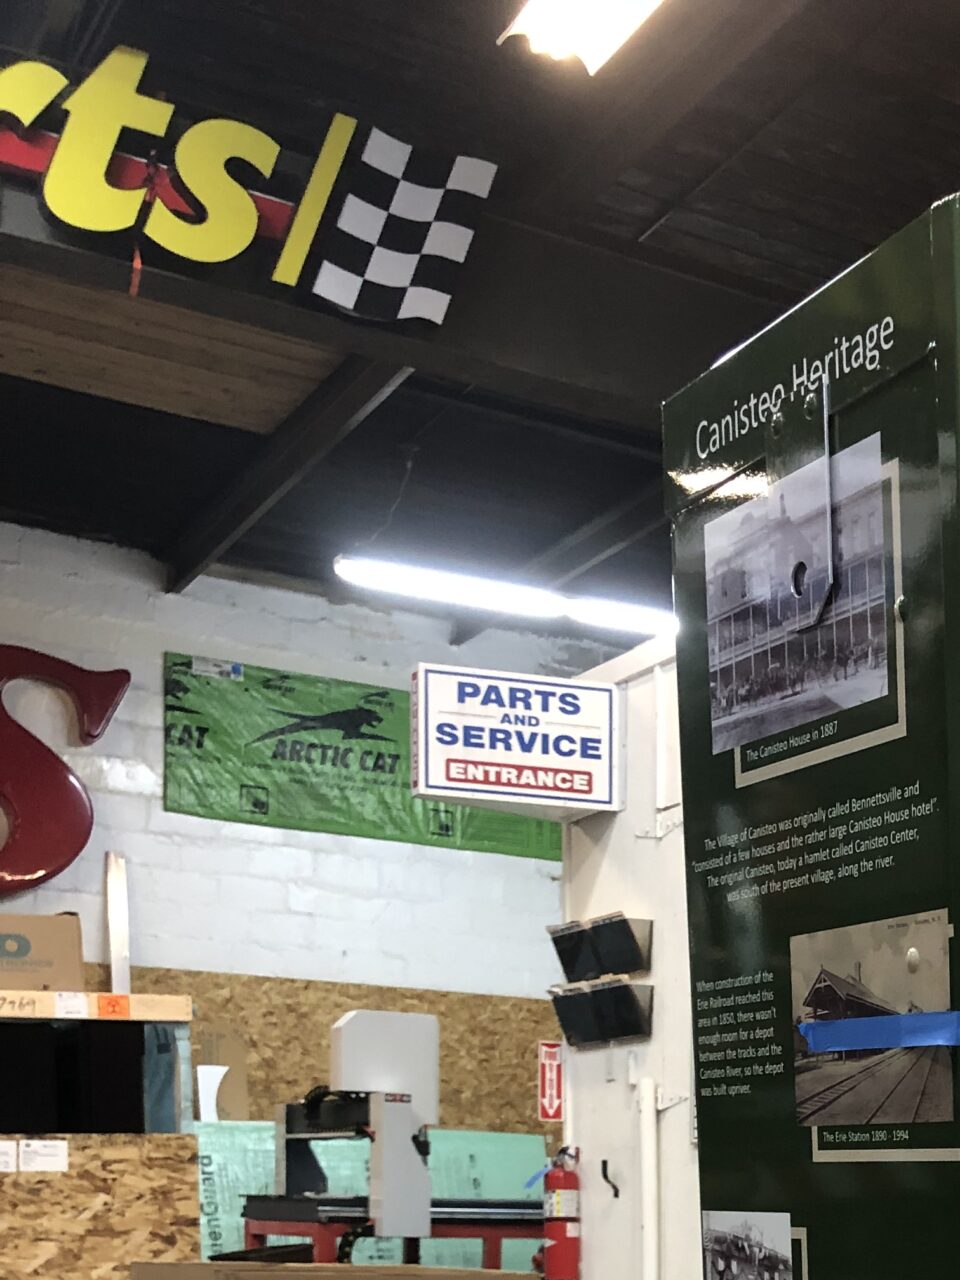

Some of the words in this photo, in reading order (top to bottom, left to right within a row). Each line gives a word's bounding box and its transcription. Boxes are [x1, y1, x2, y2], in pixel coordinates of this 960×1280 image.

[695, 383, 785, 459] Canisteo
[792, 316, 895, 391] Heritage
[457, 681, 581, 715] PARTS
[500, 713, 540, 727] AND
[271, 738, 354, 769] ARCTIC
[359, 750, 401, 774] CAT
[435, 722, 602, 760] SERVICE
[746, 748, 758, 762] The
[759, 738, 788, 758] Canisteo
[789, 732, 811, 751] House
[812, 729, 819, 740] in
[820, 720, 838, 739] 1887
[450, 762, 590, 791] ENTRANCE
[704, 838, 717, 851] The
[717, 832, 738, 848] Village
[740, 827, 747, 841] of
[748, 822, 777, 840] Canisteo
[778, 819, 792, 831] was
[793, 807, 826, 829] originally
[828, 799, 849, 818] called
[851, 786, 901, 812] Bennettsville
[904, 780, 920, 798] and
[823, 1131, 834, 1142] The
[835, 1131, 846, 1142] Erie
[848, 1131, 870, 1142] Station
[871, 1130, 887, 1141] 1890
[893, 1130, 909, 1141] 1994
